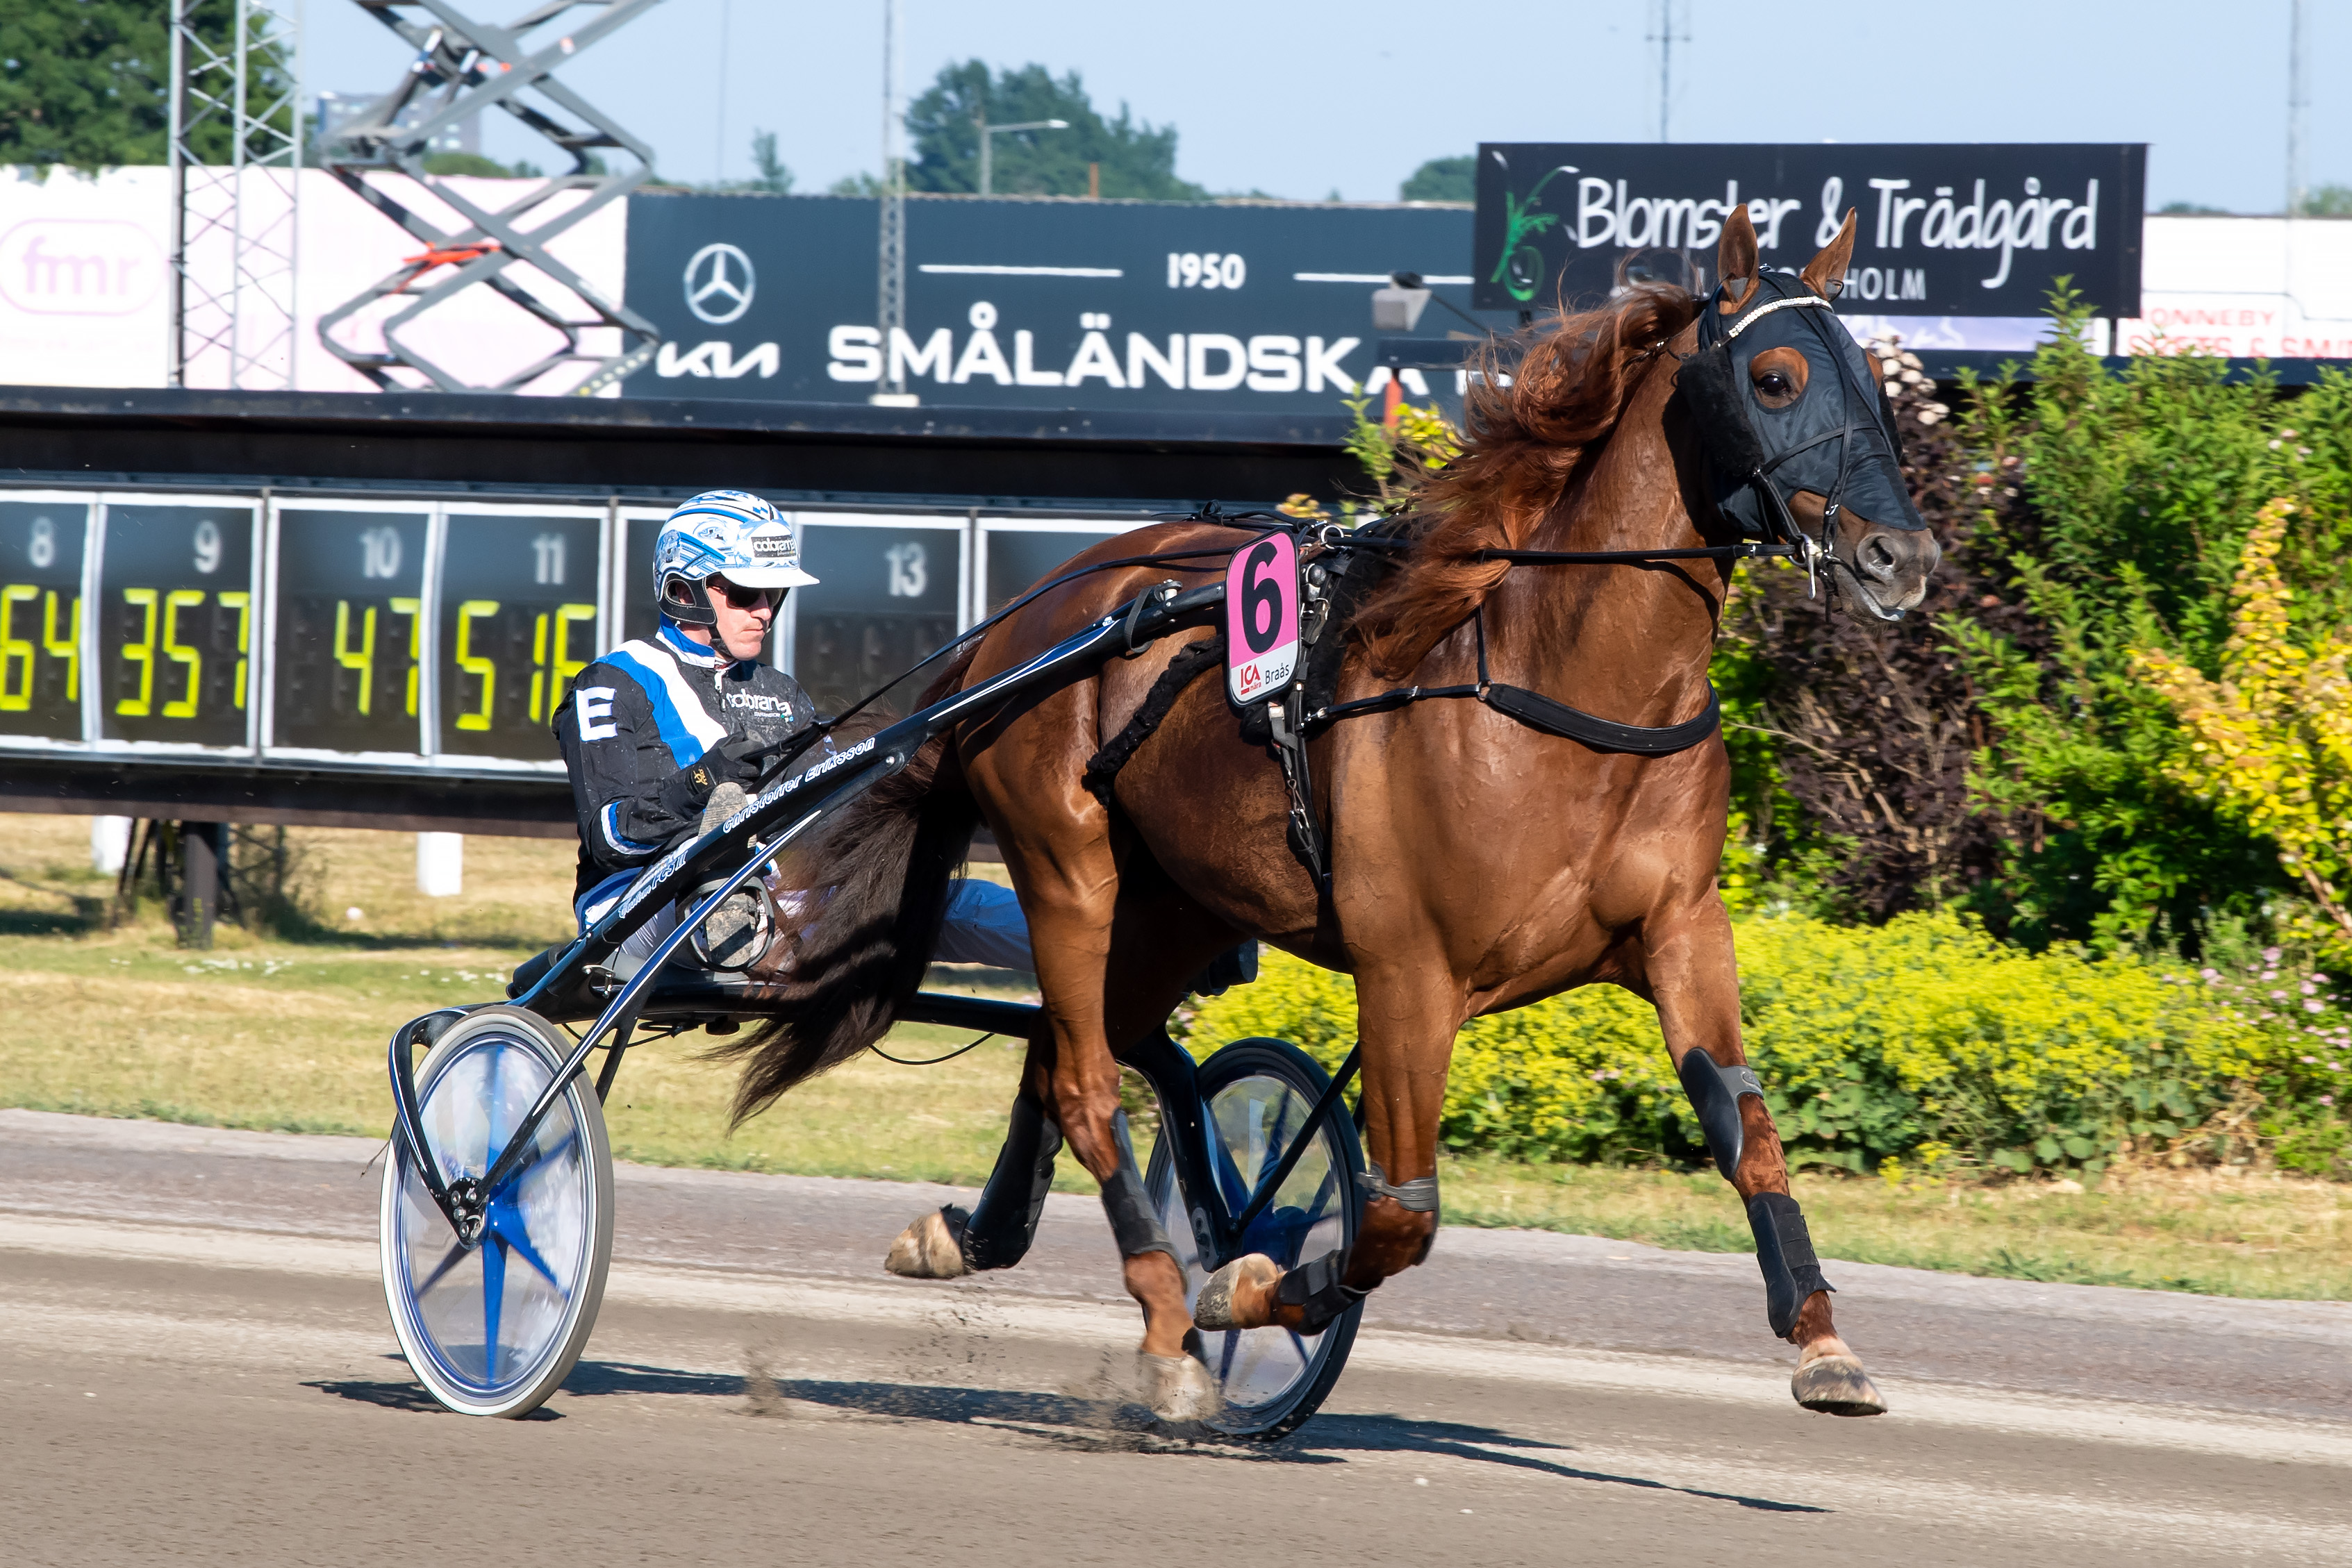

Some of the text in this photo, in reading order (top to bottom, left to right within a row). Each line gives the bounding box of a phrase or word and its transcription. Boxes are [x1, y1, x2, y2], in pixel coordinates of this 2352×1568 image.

[1577, 176, 2100, 289] Blomster & Trädgård
[22, 234, 142, 296] fmr
[1167, 252, 1247, 290] 1950
[2130, 308, 2276, 326] ONNEBY
[655, 340, 781, 378] KIA
[28, 515, 56, 569] 8
[193, 519, 223, 574] 9
[360, 526, 403, 579] 10
[532, 532, 568, 585] 11
[886, 542, 929, 598] 13
[1241, 542, 1282, 653] 6
[115, 587, 250, 718] 357
[333, 597, 421, 717] 47
[1241, 662, 1290, 687] ICA Braås
[576, 686, 618, 742] E
[723, 737, 876, 833] Christoffer Eriksson
